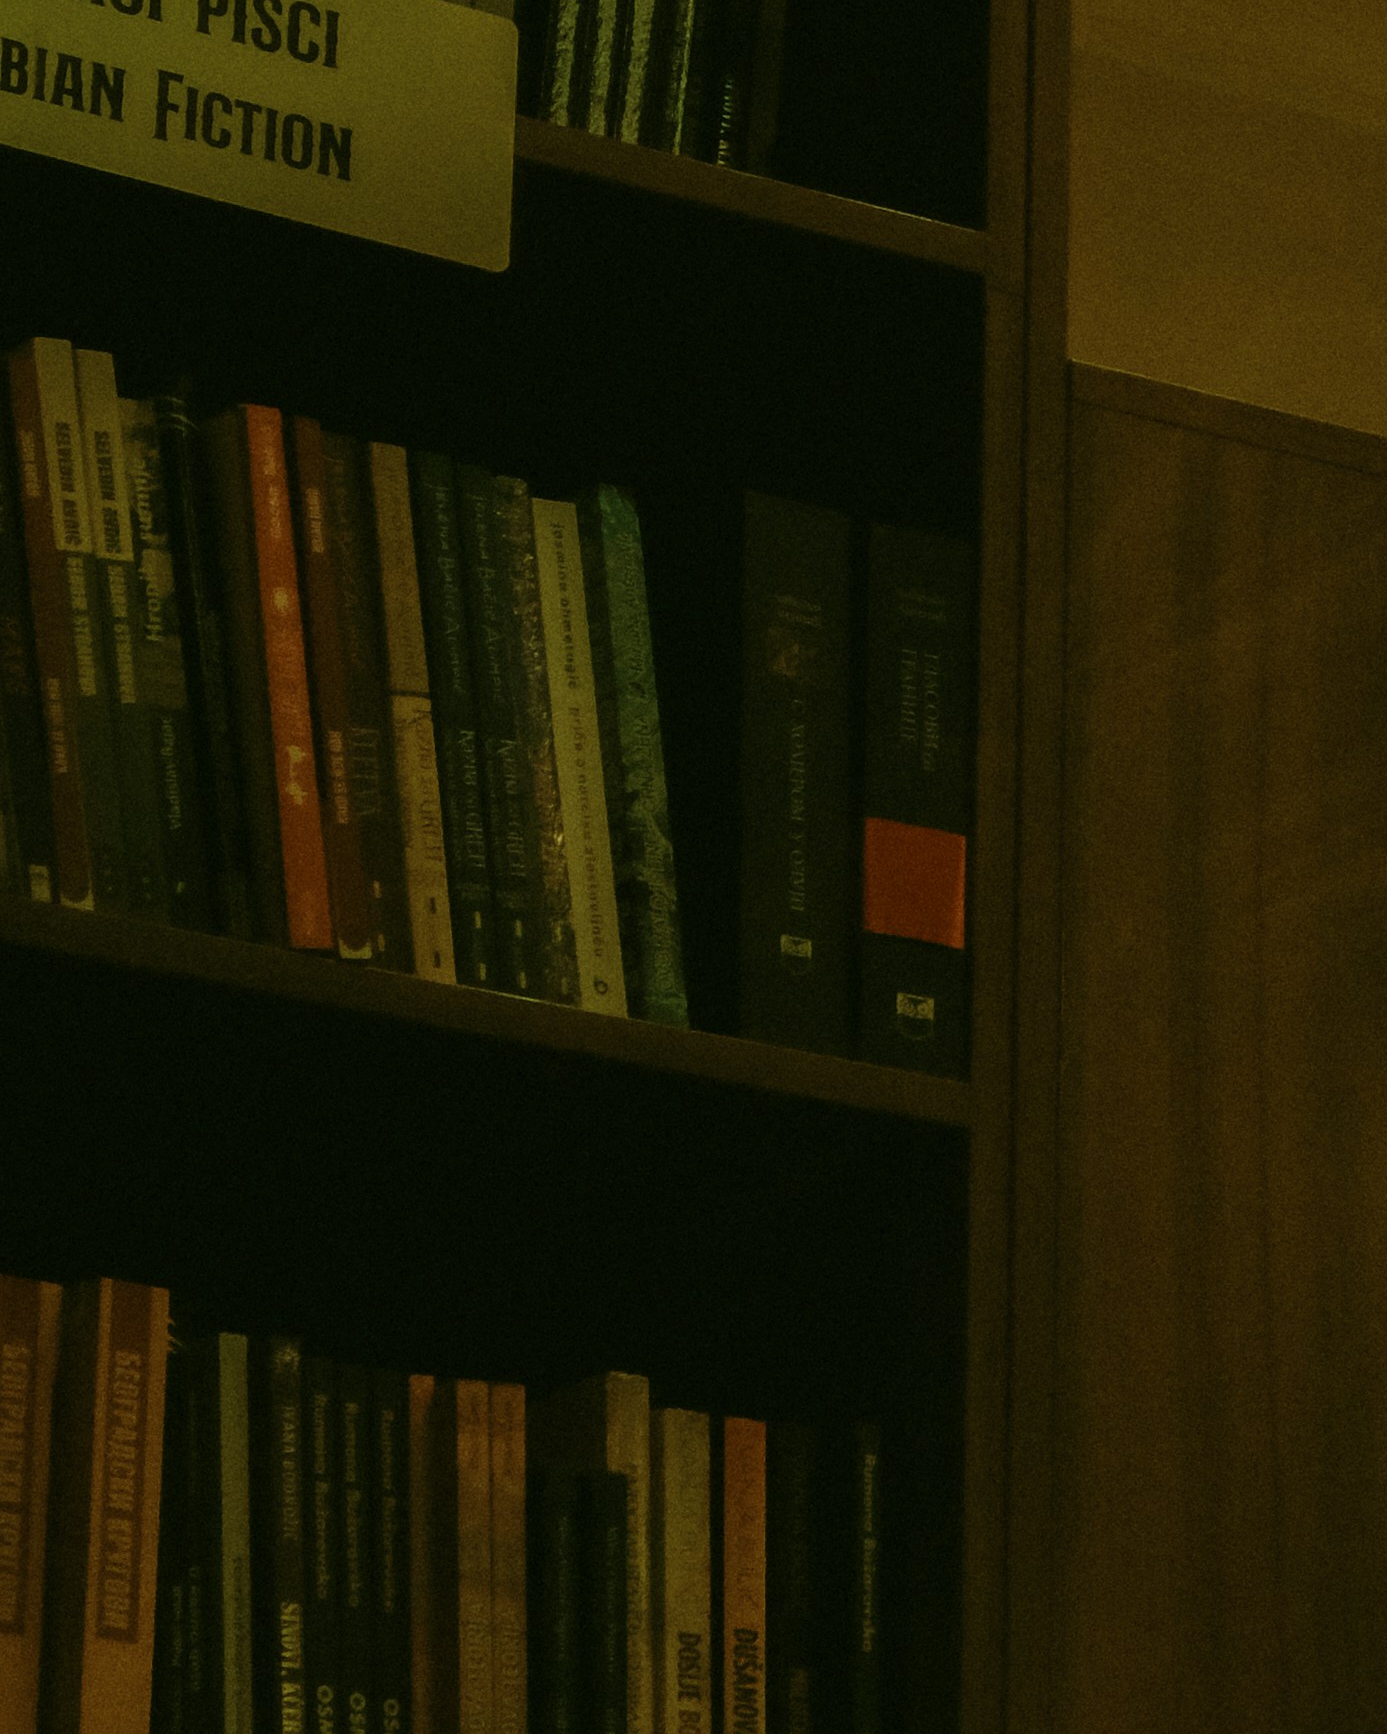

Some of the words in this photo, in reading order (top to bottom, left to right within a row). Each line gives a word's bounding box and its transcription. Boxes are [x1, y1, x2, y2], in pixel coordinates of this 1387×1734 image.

[106, 1349, 143, 1509] БЕОГРАДСКИ
[102, 1518, 136, 1630] КРУГОВИ
[675, 1631, 704, 1703] DOSIJE
